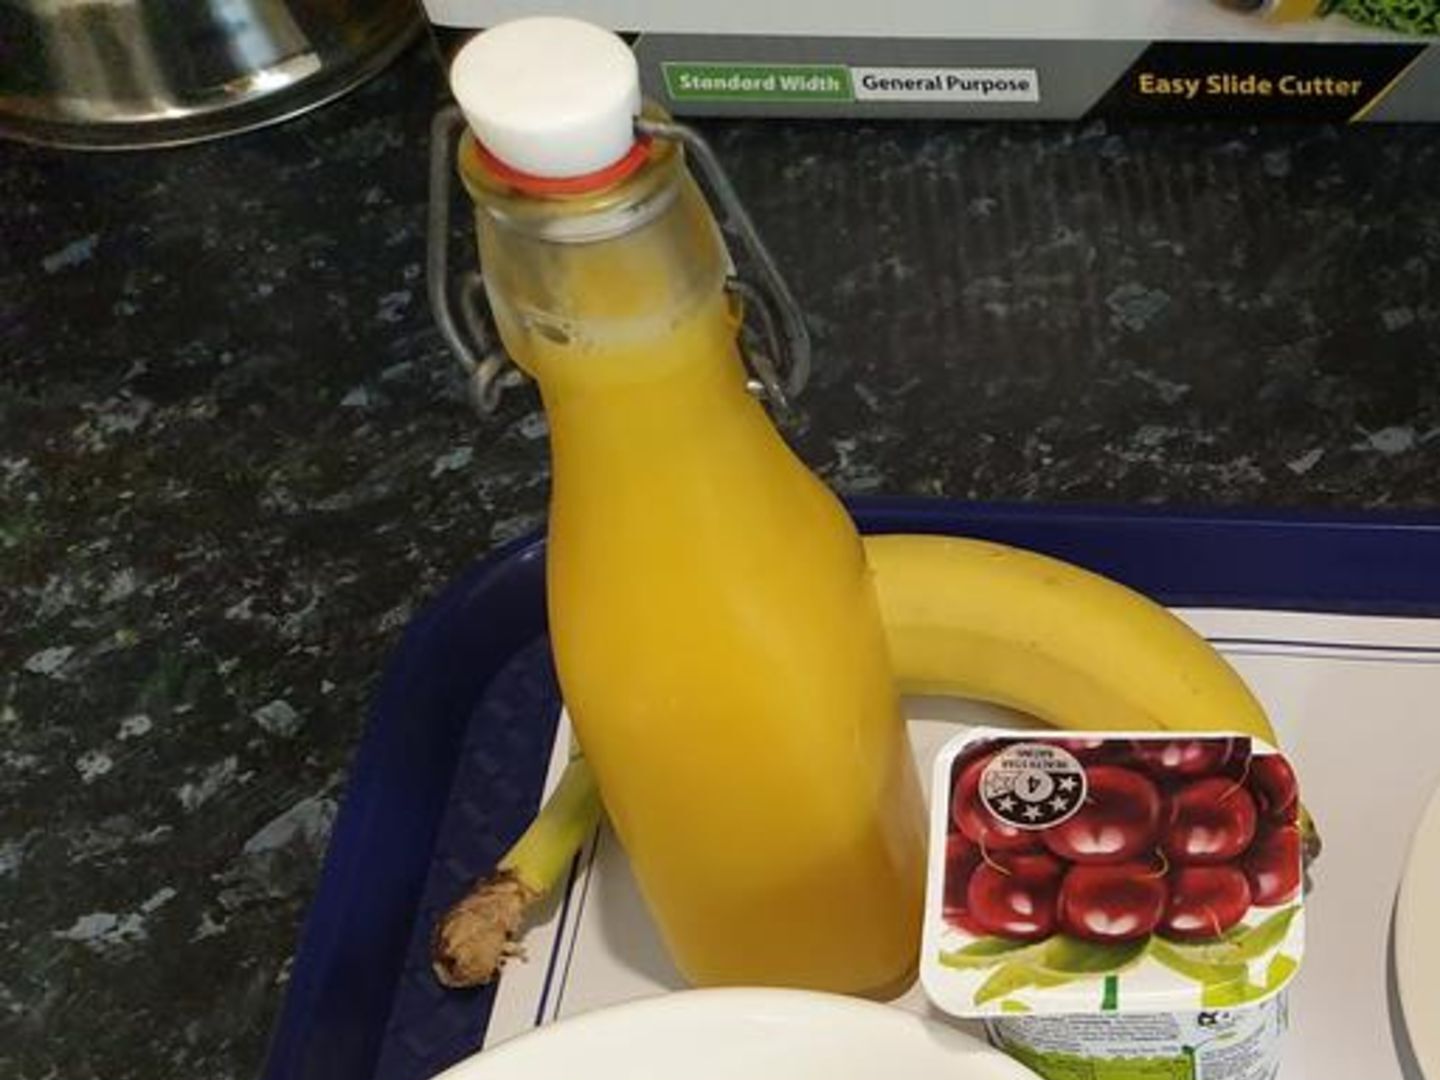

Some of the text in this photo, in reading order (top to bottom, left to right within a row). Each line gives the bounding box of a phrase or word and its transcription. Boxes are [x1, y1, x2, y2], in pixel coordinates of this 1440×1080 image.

[678, 73, 841, 93] Standard Width
[861, 74, 1031, 95] General Purpose
[1138, 73, 1362, 98] Easy Slide Cutter
[1027, 775, 1042, 794] 4
